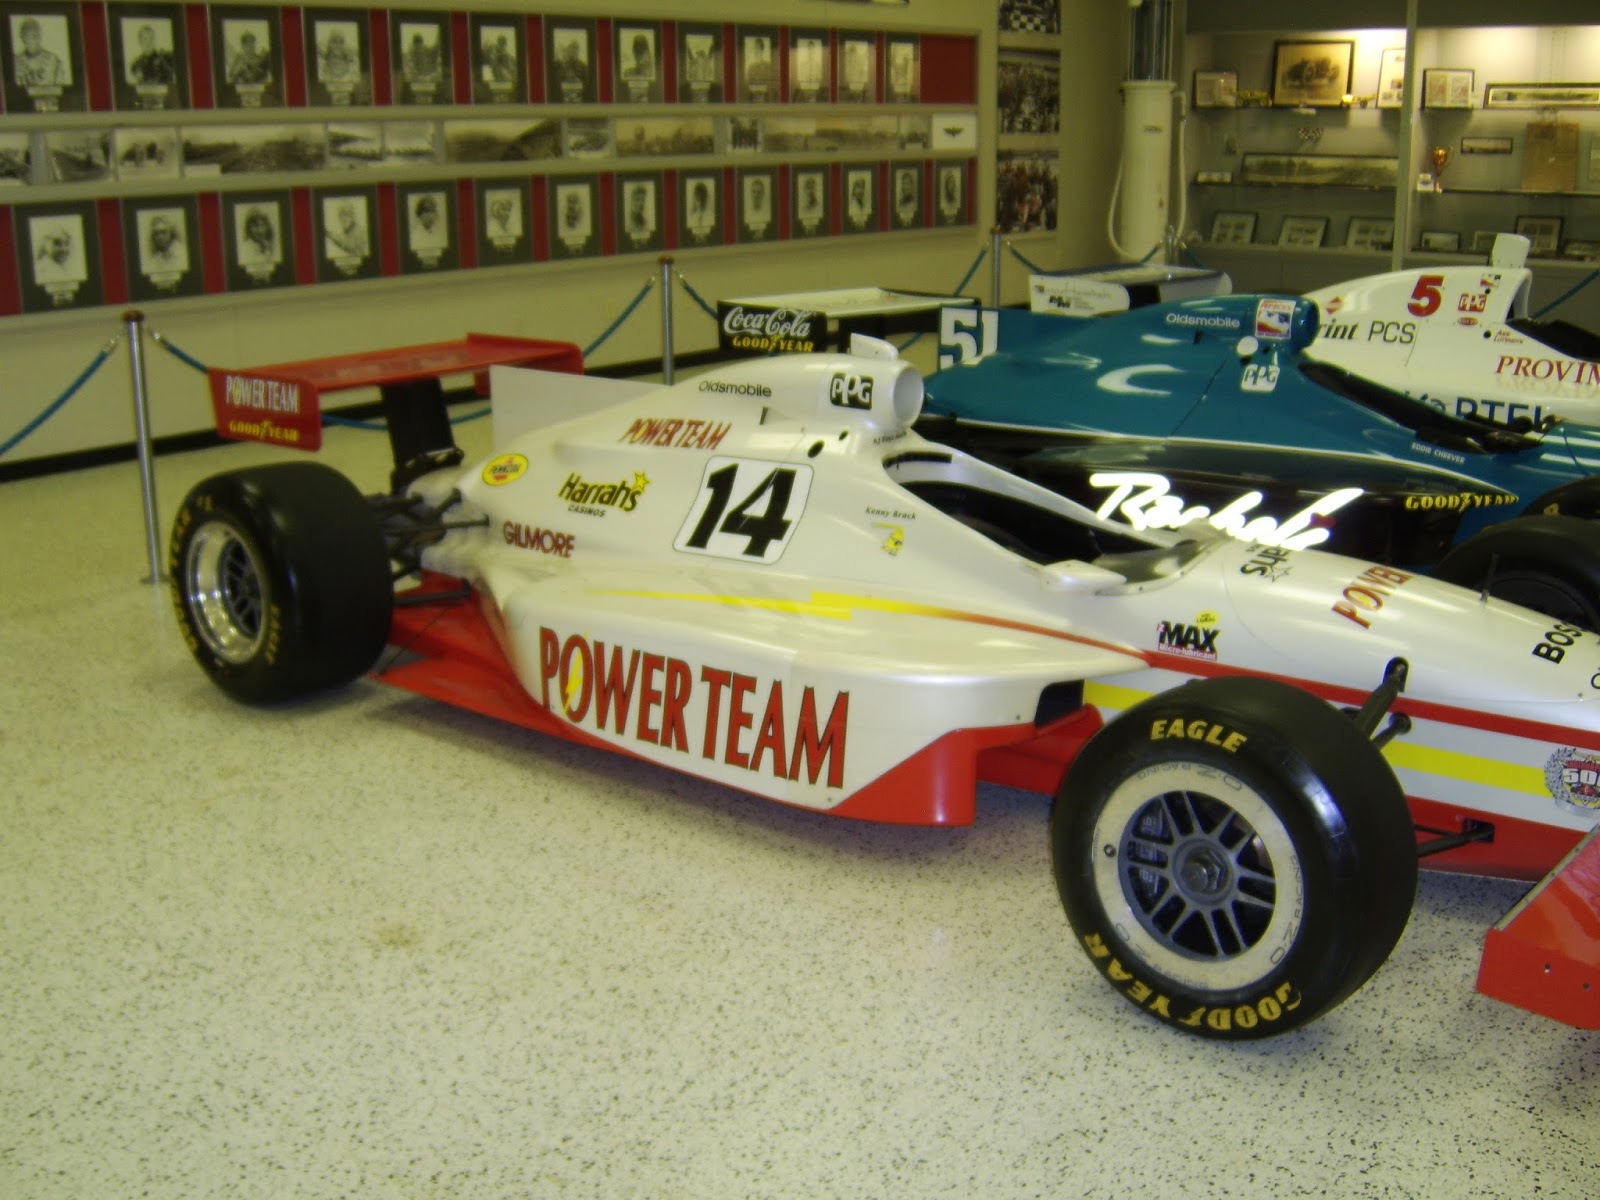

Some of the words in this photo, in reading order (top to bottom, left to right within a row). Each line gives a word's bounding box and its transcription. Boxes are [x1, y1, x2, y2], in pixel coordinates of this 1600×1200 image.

[1408, 276, 1445, 317] 5
[724, 306, 813, 337] Coca-Cola
[1166, 313, 1240, 328] Oldsmobile
[1368, 321, 1416, 344] PCS
[732, 335, 814, 352] GOODYEAR
[226, 375, 265, 409] POWER
[266, 381, 298, 413] TEAM
[699, 379, 772, 398] Oldsmobile
[831, 374, 873, 408] PPG
[617, 418, 685, 447] POWER
[674, 420, 732, 450] TEAM
[1411, 442, 1432, 454] EDDIE
[1434, 449, 1465, 465] CHEEVER
[568, 504, 606, 518] CASINOS
[686, 463, 797, 557] 14
[865, 506, 890, 519] Kenny
[503, 520, 575, 558] GILMORE
[539, 626, 692, 753] POWER
[700, 664, 849, 789] TEAM
[1151, 719, 1248, 753] EAGLE
